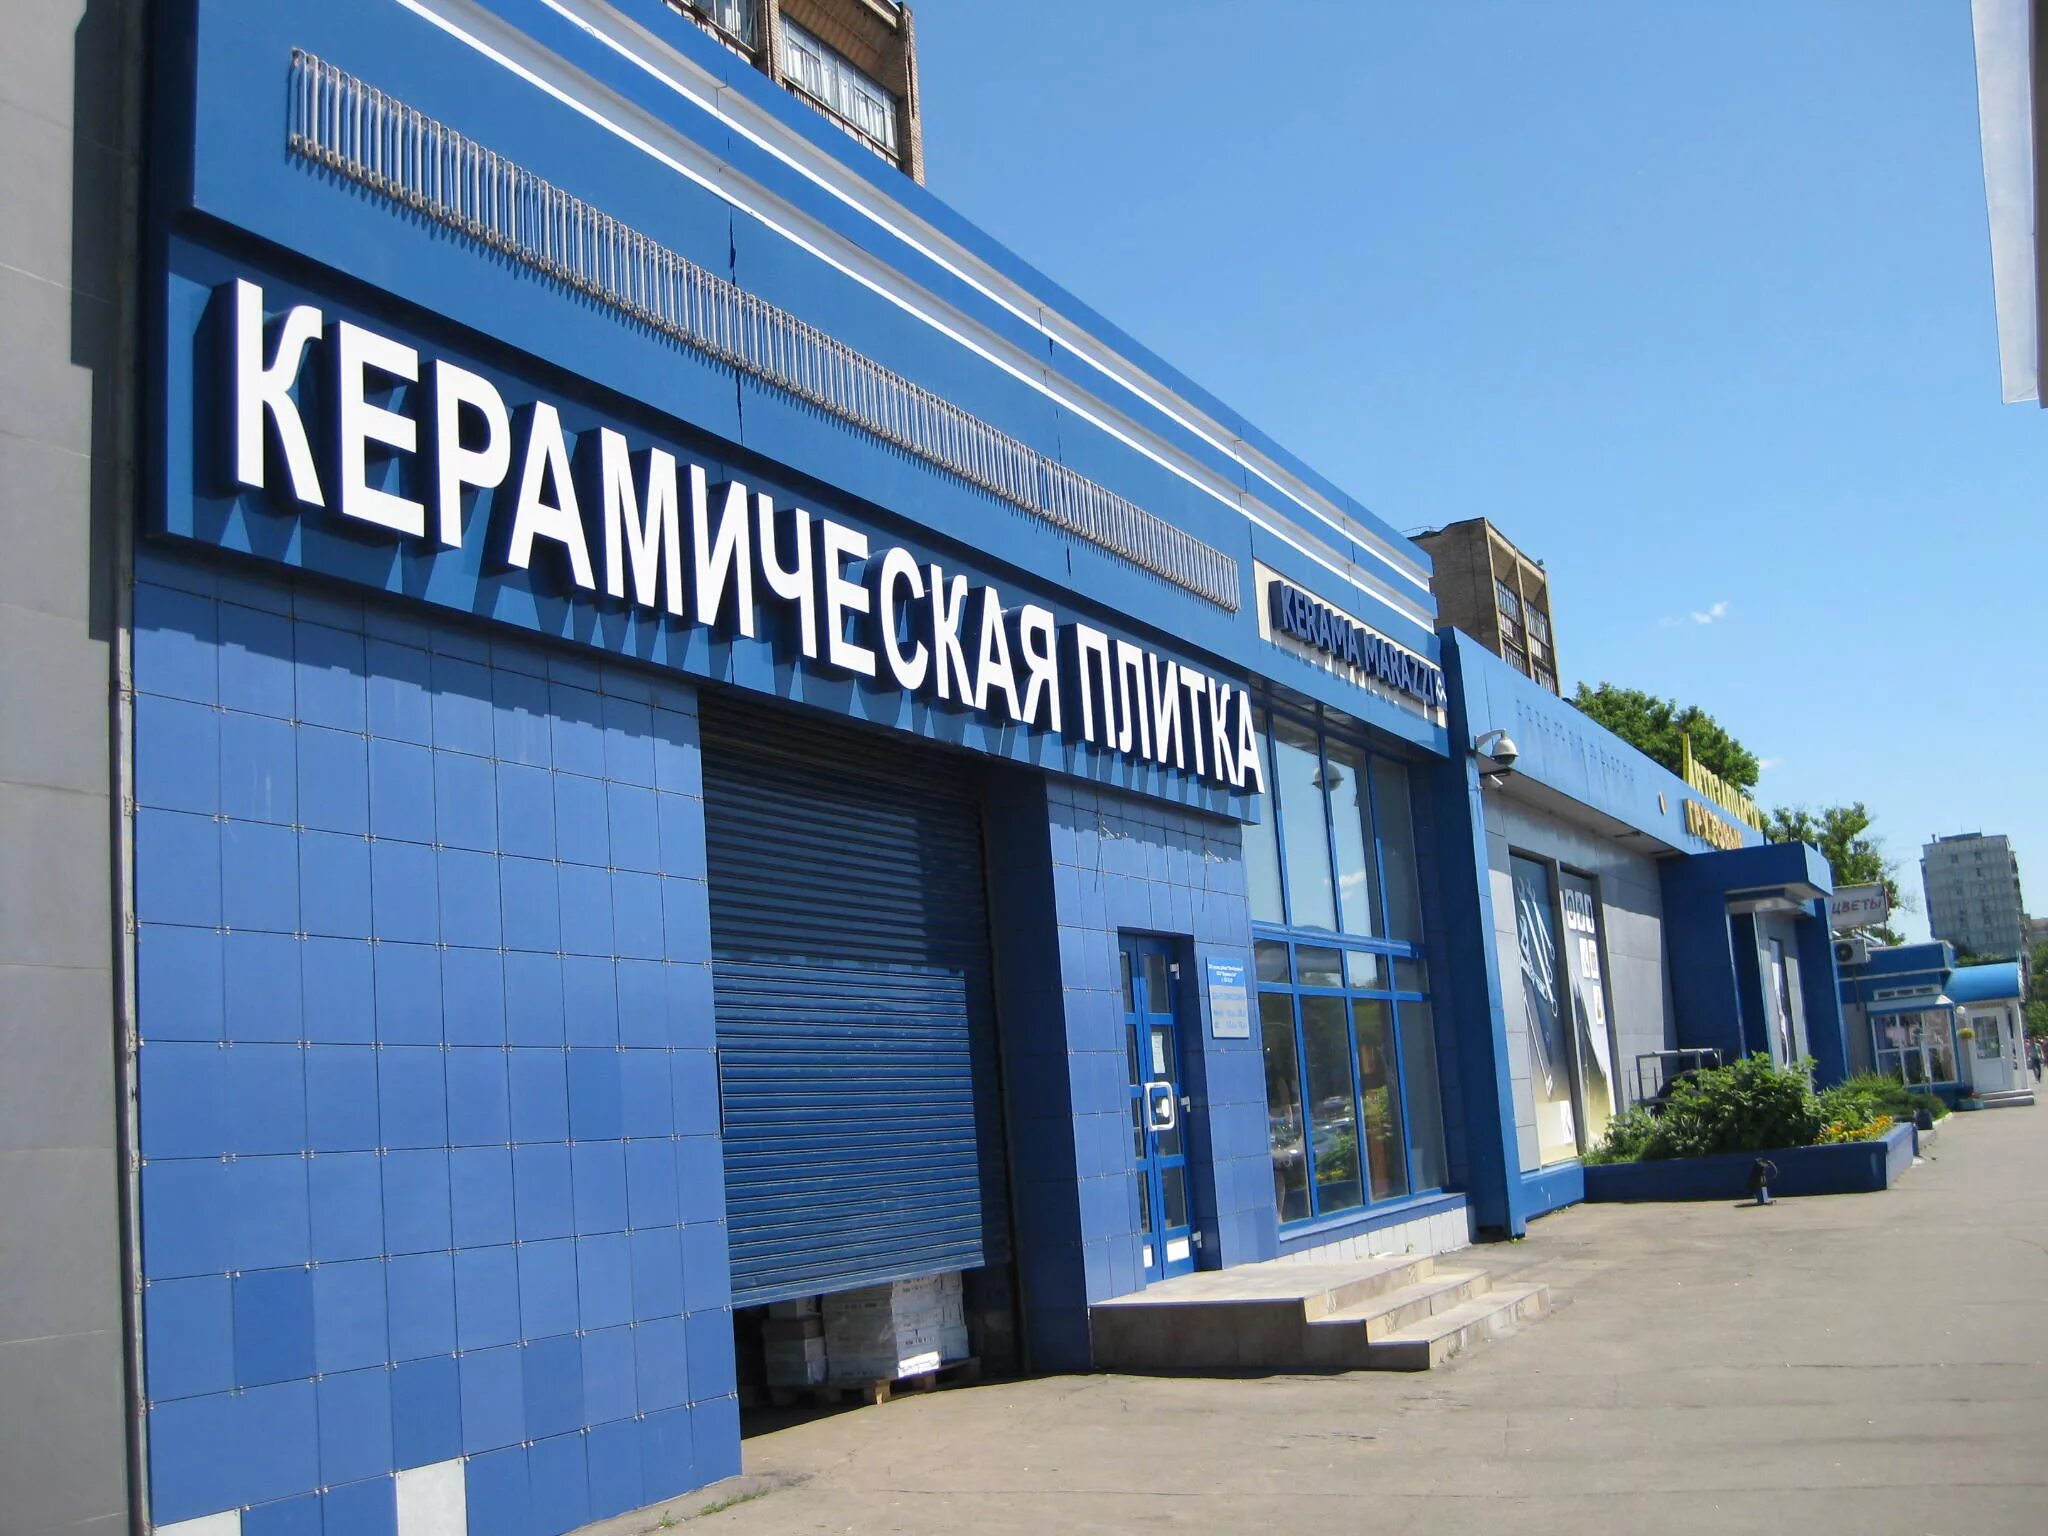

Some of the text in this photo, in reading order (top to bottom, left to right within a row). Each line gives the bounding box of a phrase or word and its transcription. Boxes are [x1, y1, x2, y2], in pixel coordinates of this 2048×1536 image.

[234, 278, 1265, 793] КЕРАМИЧЕСКАЯ ПЛИТКА
[1277, 583, 1436, 707] KERAMA MARAZZI
[1831, 898, 1882, 914] ЦВЕТЫ
